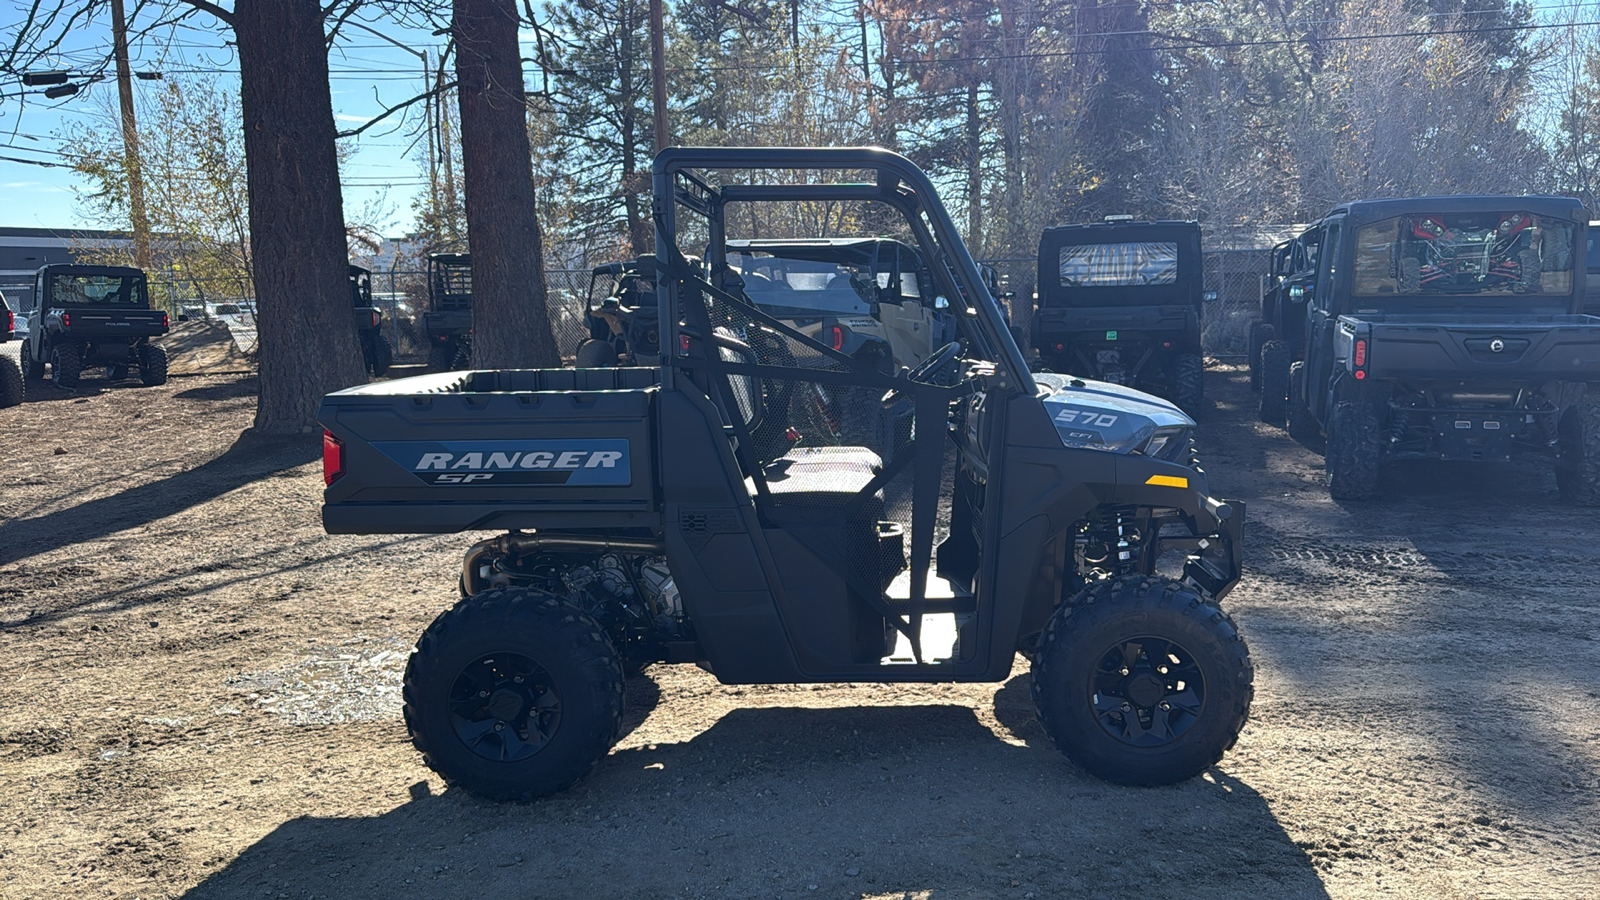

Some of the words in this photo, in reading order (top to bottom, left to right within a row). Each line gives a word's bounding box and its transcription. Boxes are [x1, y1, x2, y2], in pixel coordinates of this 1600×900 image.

[1055, 409, 1118, 427] 570
[415, 451, 623, 470] RANGER
[434, 473, 494, 483] SP
